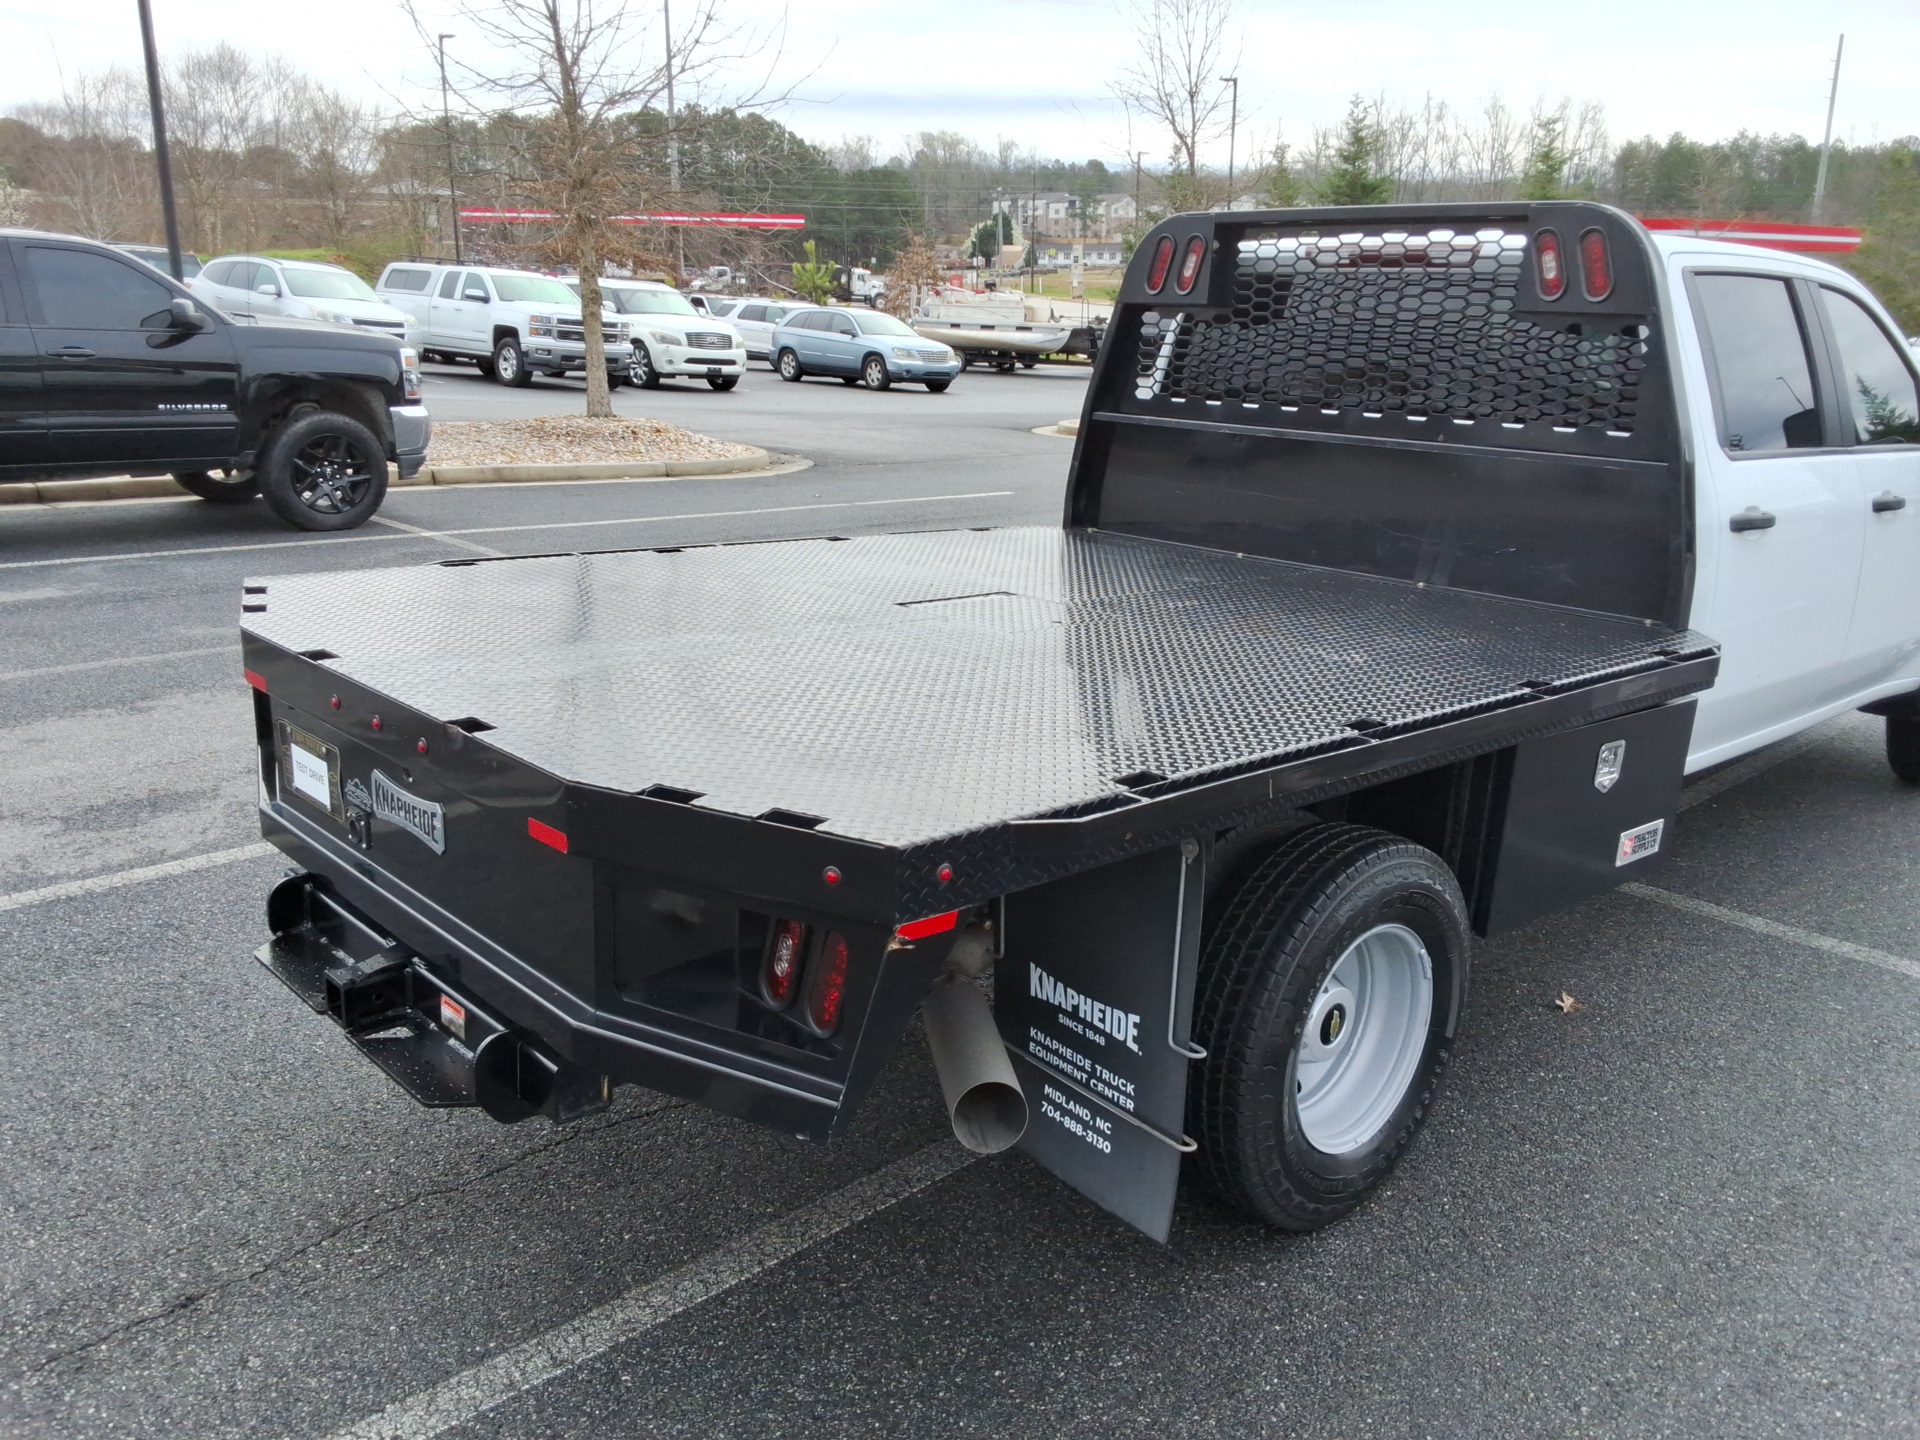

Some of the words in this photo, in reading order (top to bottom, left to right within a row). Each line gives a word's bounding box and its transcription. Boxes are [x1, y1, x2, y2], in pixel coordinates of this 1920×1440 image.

[158, 403, 228, 411] SILVERADO
[295, 760, 308, 776] TEST
[308, 768, 325, 785] DRIVE
[375, 779, 439, 845] KNAPHEIDE
[1058, 1013, 1084, 1035] SINCE
[1085, 1026, 1106, 1046] 1848
[1029, 1026, 1092, 1071] KNAPHEIDE
[1095, 1063, 1136, 1096] TRUCK
[1029, 1041, 1088, 1084] EQUIPMENT
[1090, 1078, 1135, 1113] CENTER
[1041, 1100, 1112, 1154] 704-888-3130
[1044, 1083, 1094, 1126] MIDLAND,
[1096, 1115, 1112, 1136] NC
